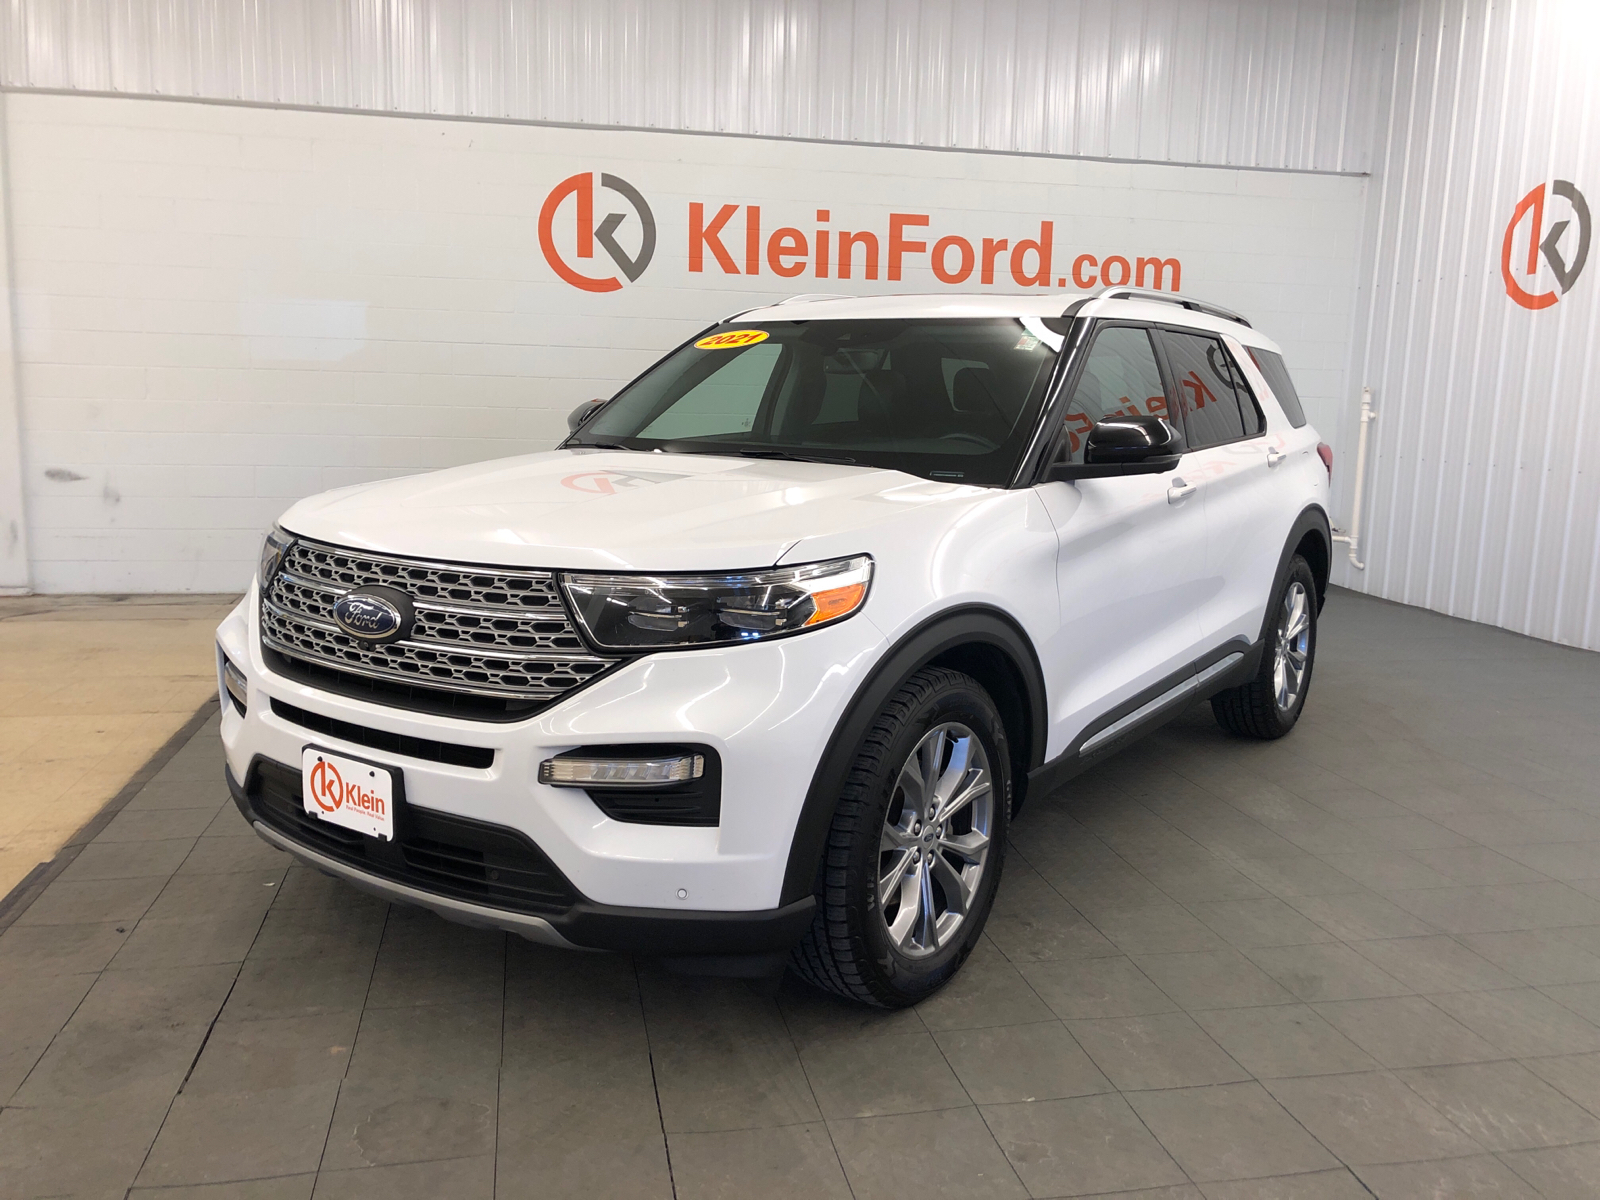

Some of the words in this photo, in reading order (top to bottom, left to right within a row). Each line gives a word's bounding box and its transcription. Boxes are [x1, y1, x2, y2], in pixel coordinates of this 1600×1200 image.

[688, 202, 1183, 292] KleinFord.com
[699, 333, 763, 346] 2021
[344, 601, 382, 630] Ford
[345, 781, 385, 816] Klein
